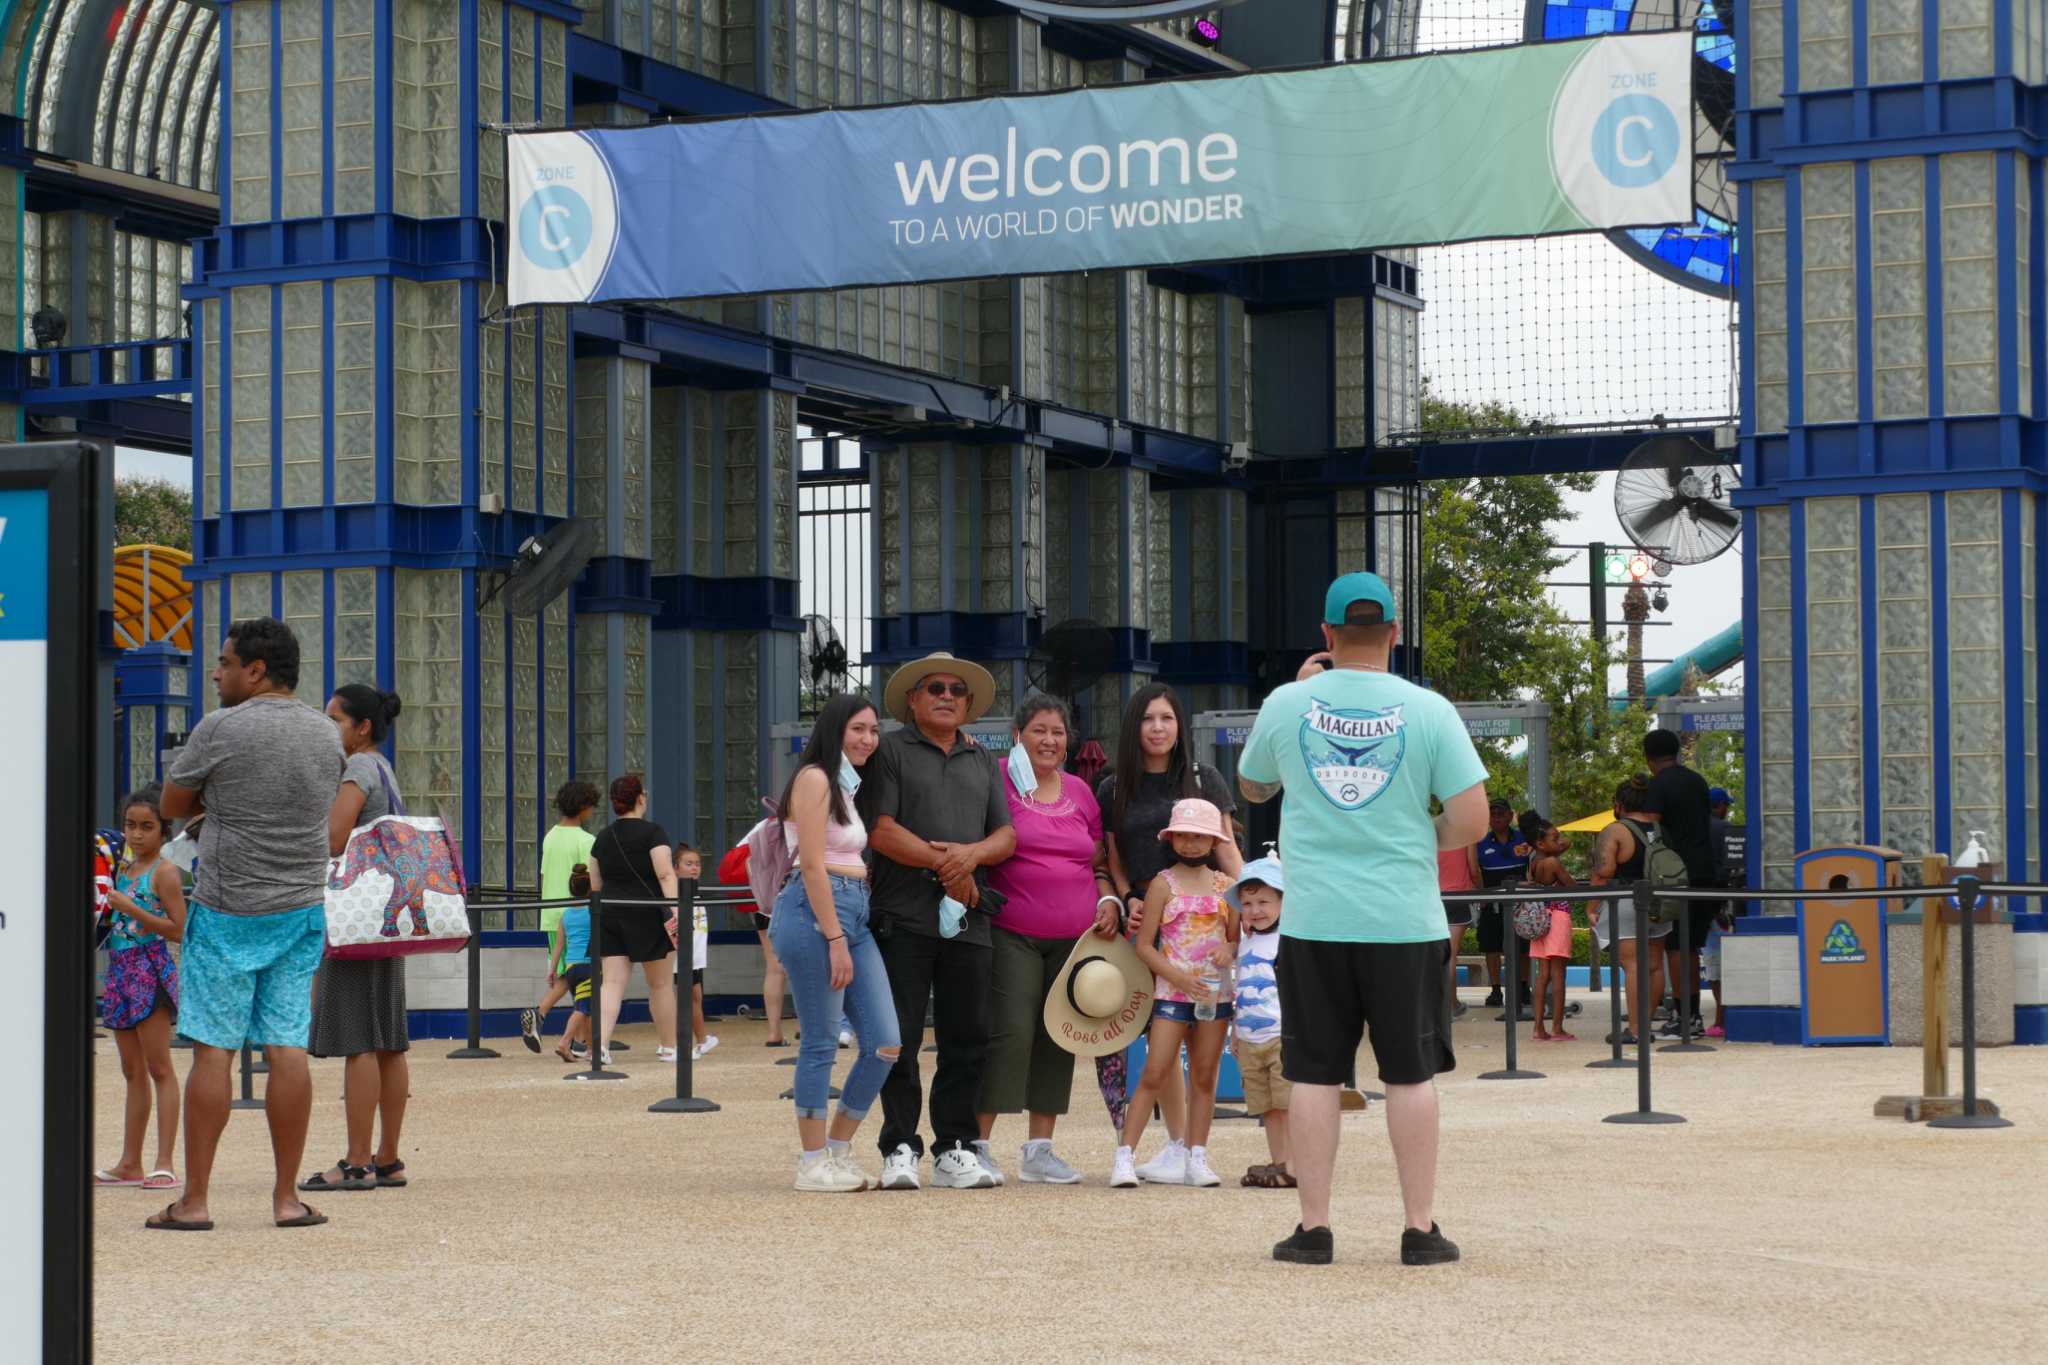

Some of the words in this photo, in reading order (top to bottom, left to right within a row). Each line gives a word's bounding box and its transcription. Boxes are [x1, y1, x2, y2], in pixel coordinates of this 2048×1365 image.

[1609, 72, 1657, 88] ZONE
[1615, 114, 1654, 168] C
[536, 165, 576, 181] ZONE
[894, 126, 1239, 206] welcome
[539, 204, 571, 251] C
[889, 219, 925, 246] TO
[930, 217, 950, 242] A
[955, 209, 1058, 241] WORLD
[1065, 206, 1105, 232] OF
[1110, 193, 1244, 230] WONDER
[1471, 719, 1490, 728] WAIT
[1493, 719, 1510, 728] FOR
[1694, 713, 1728, 721] PLEASE
[1729, 713, 1744, 721] WA
[1226, 727, 1249, 736] PLEA
[1316, 713, 1395, 738] MAGELLAN
[1485, 728, 1509, 736] LIGHT
[1694, 722, 1712, 731] THE
[1103, 1018, 1122, 1041] all
[1121, 990, 1149, 1024] Day
